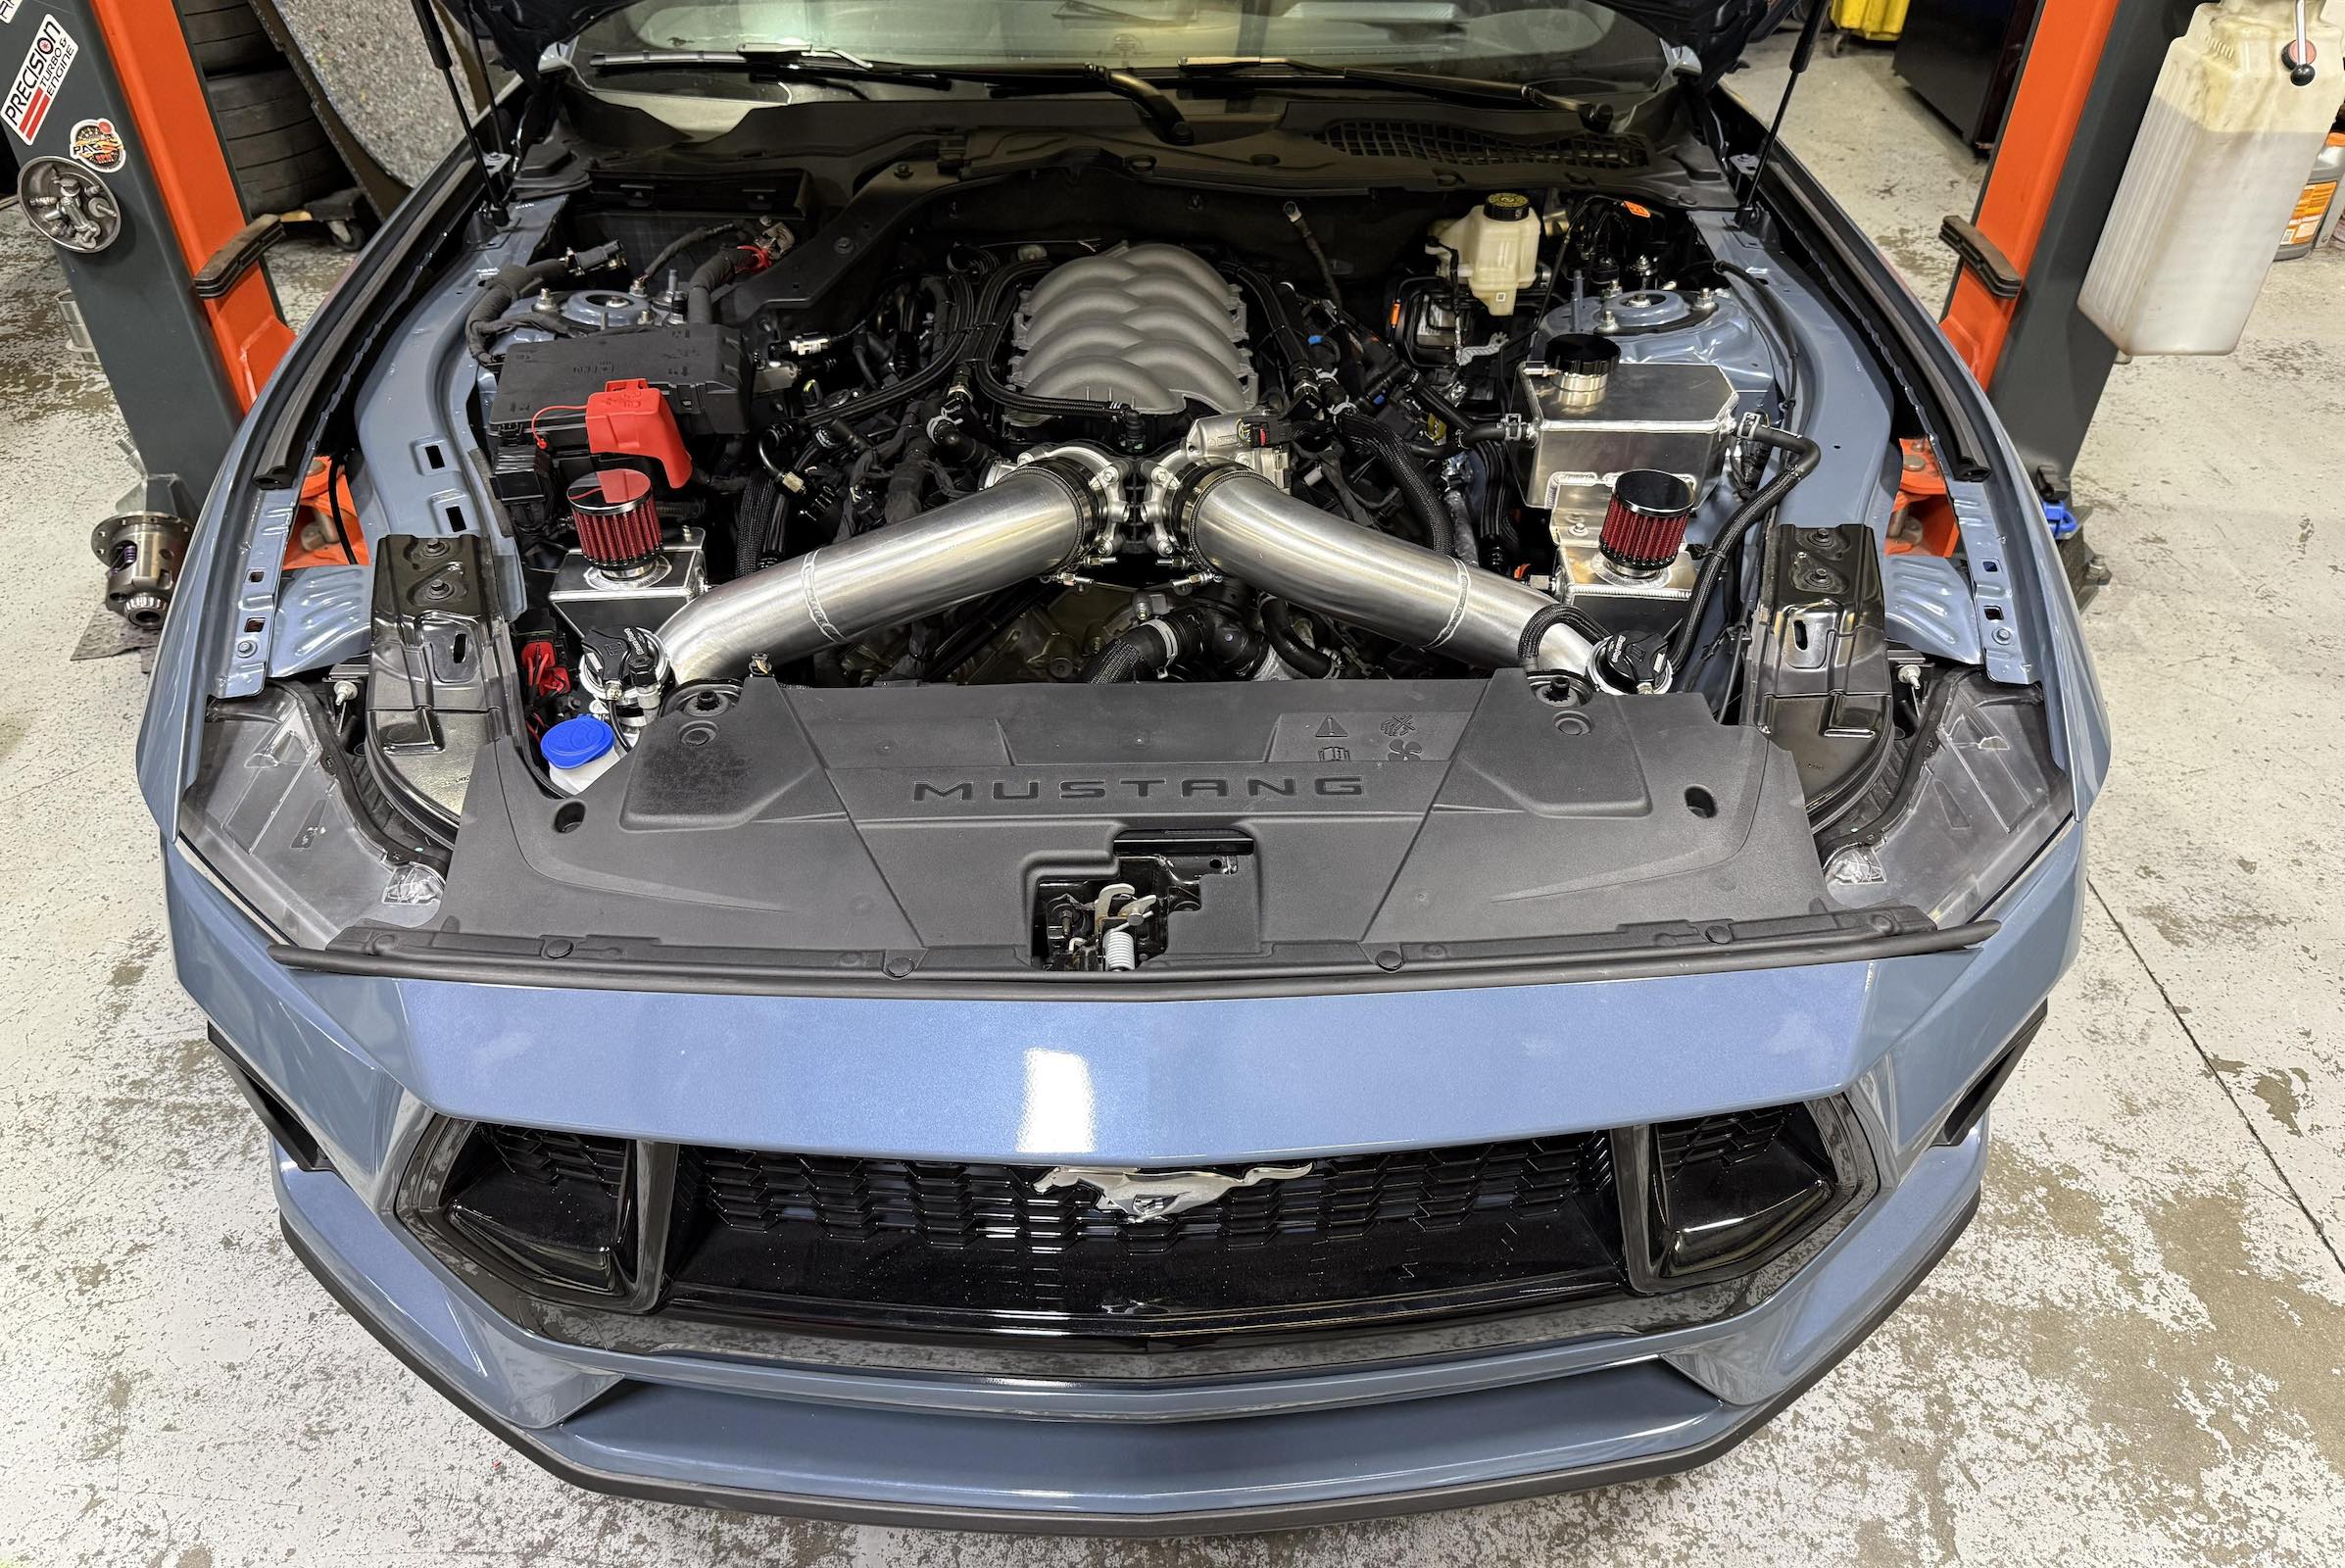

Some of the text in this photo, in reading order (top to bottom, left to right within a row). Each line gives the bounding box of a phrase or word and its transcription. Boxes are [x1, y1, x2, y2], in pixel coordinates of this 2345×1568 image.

[39, 37, 68, 88] TURBO &
[47, 44, 74, 96] ENGINE
[912, 775, 1363, 803] MUSTANG
